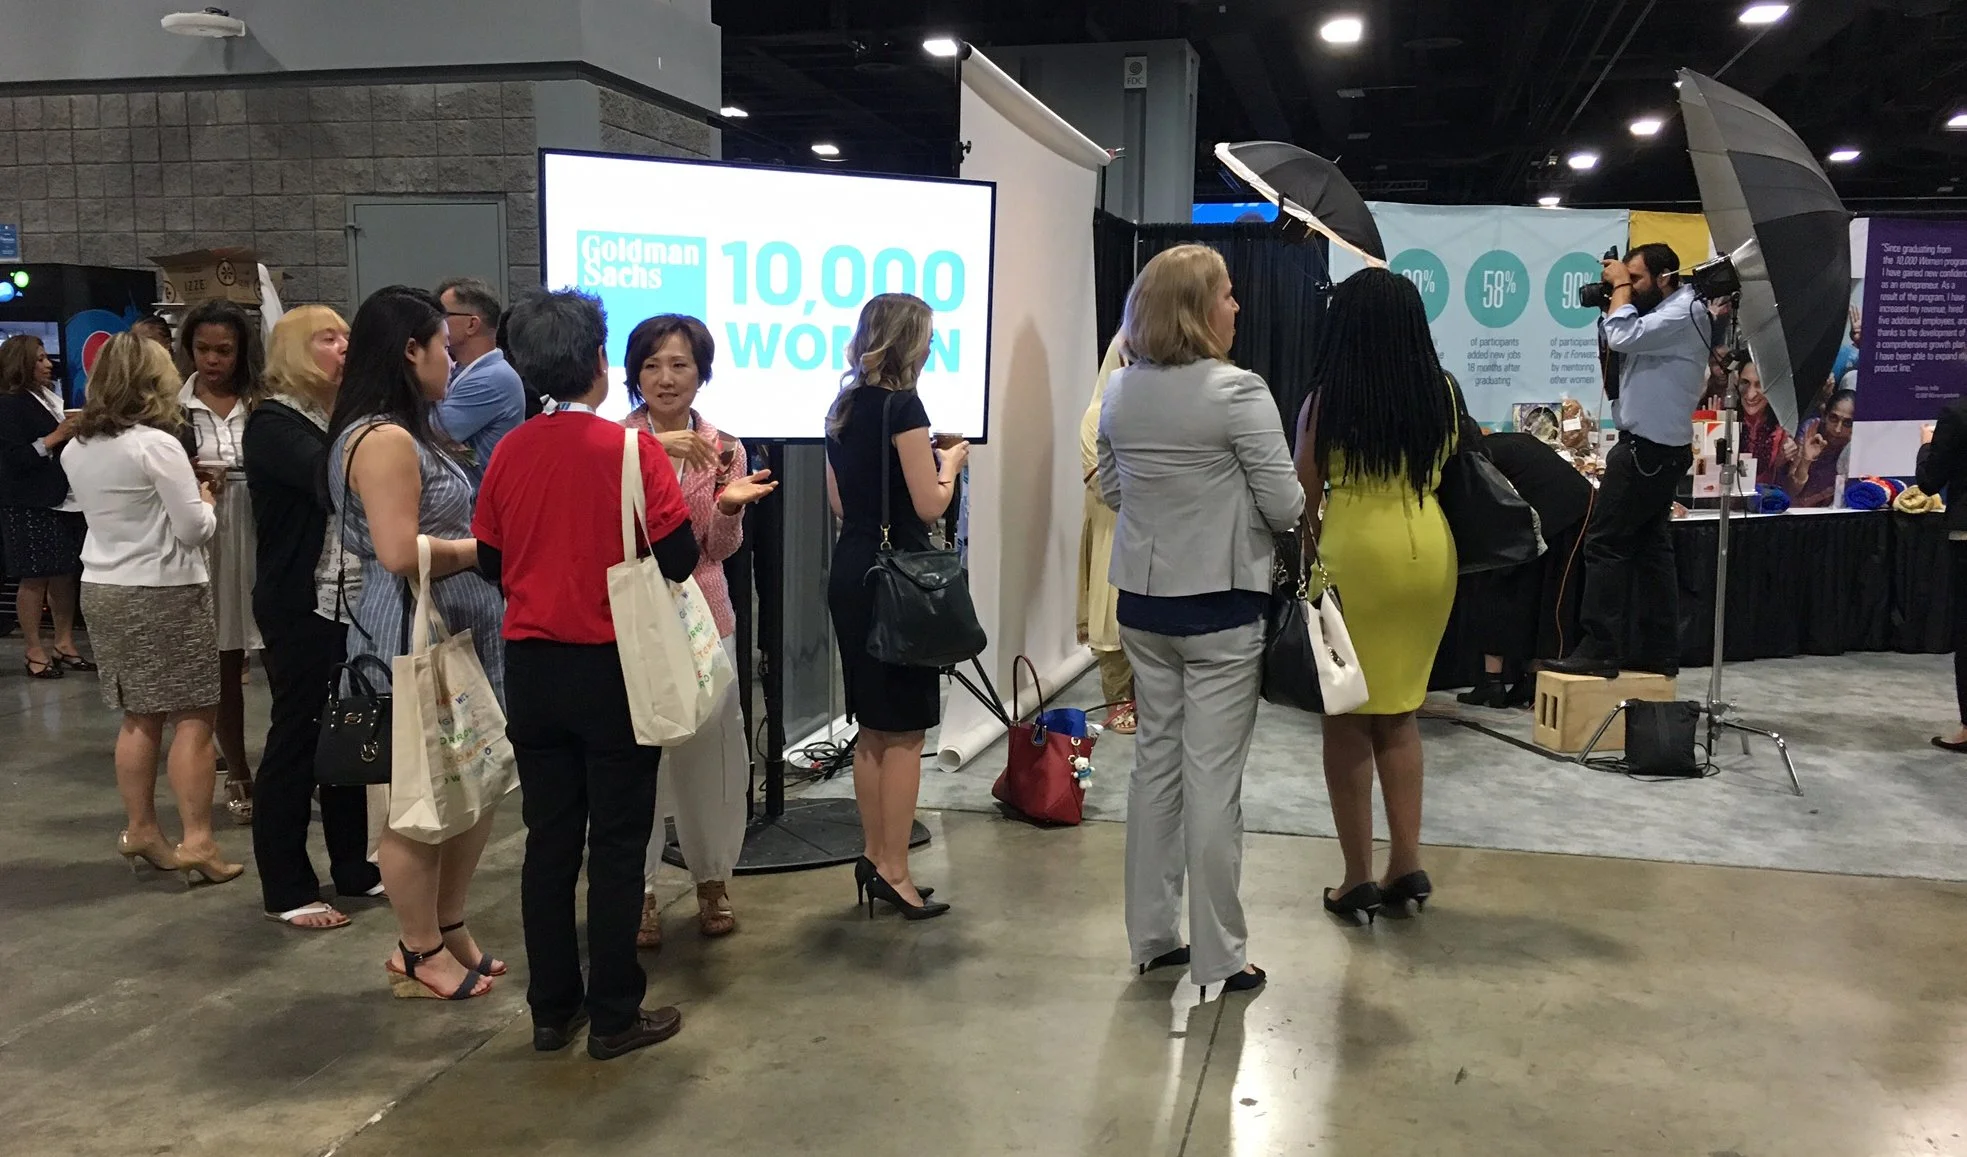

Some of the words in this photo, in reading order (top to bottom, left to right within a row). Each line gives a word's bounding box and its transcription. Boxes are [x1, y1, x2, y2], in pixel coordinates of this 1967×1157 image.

[582, 235, 699, 267] Goldman
[1902, 244, 1936, 256] graduating
[1936, 244, 1952, 254] from
[1882, 256, 1894, 265] the
[1896, 256, 1918, 265] 10,000
[1919, 257, 1944, 265] Women
[583, 263, 664, 289] Sachs
[721, 240, 966, 317] 10,000
[1886, 268, 1901, 277] have
[1902, 268, 1924, 279] gained
[1483, 270, 1516, 308] 58%
[1941, 280, 1950, 289] As
[1880, 292, 1898, 301] result
[1899, 292, 1906, 301] of
[1907, 293, 1918, 301] the
[1951, 293, 1966, 301] have
[1879, 304, 1909, 313] increased
[1910, 306, 1920, 315] my
[1878, 316, 1890, 324] five
[1891, 316, 1921, 324] additional
[1878, 328, 1898, 337] thanks
[1907, 328, 1918, 337] the
[1919, 328, 1957, 338] development
[1958, 328, 1966, 337] of
[725, 320, 961, 373] WON
[1471, 338, 1477, 346] of
[1480, 338, 1519, 347] participants
[1550, 338, 1557, 346] of
[1882, 341, 1928, 350] comprehensive
[1929, 341, 1951, 350] growth
[1467, 350, 1489, 359] added
[1507, 351, 1521, 360] jobs
[1551, 350, 1561, 360] Pay
[1879, 352, 1894, 360] have
[1896, 352, 1912, 360] been
[1912, 352, 1926, 360] able
[1935, 352, 1958, 362] expand
[1468, 363, 1475, 372] 18
[1477, 364, 1502, 372] months
[1504, 364, 1521, 372] after
[1552, 364, 1559, 373] by
[1561, 364, 1594, 373] mentoring
[1874, 364, 1898, 373] product
[1475, 376, 1511, 387] graduating
[1550, 376, 1568, 384] other
